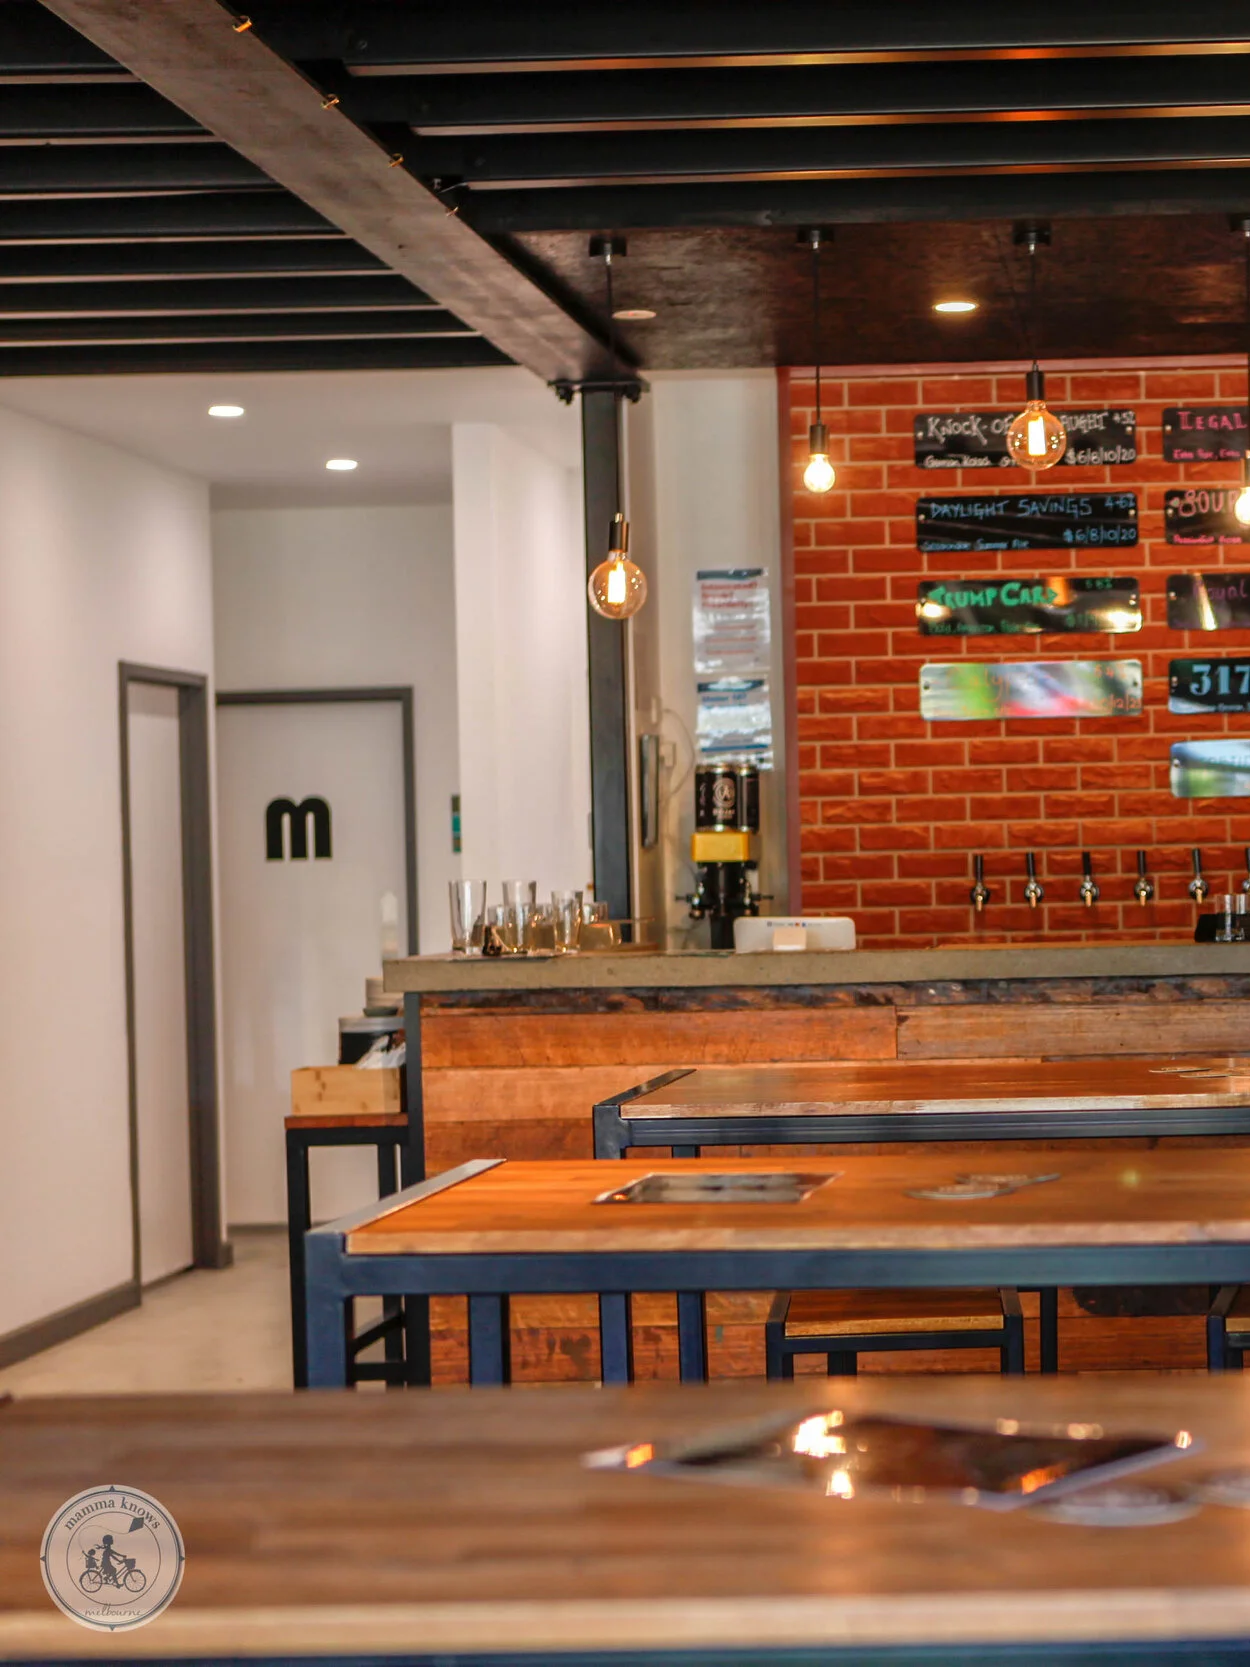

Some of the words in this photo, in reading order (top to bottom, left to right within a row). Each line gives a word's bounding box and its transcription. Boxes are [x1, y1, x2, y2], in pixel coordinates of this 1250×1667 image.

[1177, 410, 1247, 431] LEGAL
[930, 500, 1009, 520] DAYLIGHT
[1017, 498, 1092, 519] SAVINGS
[928, 585, 997, 609] TRUMP
[1001, 582, 1058, 607] CARD
[265, 795, 332, 861] m
